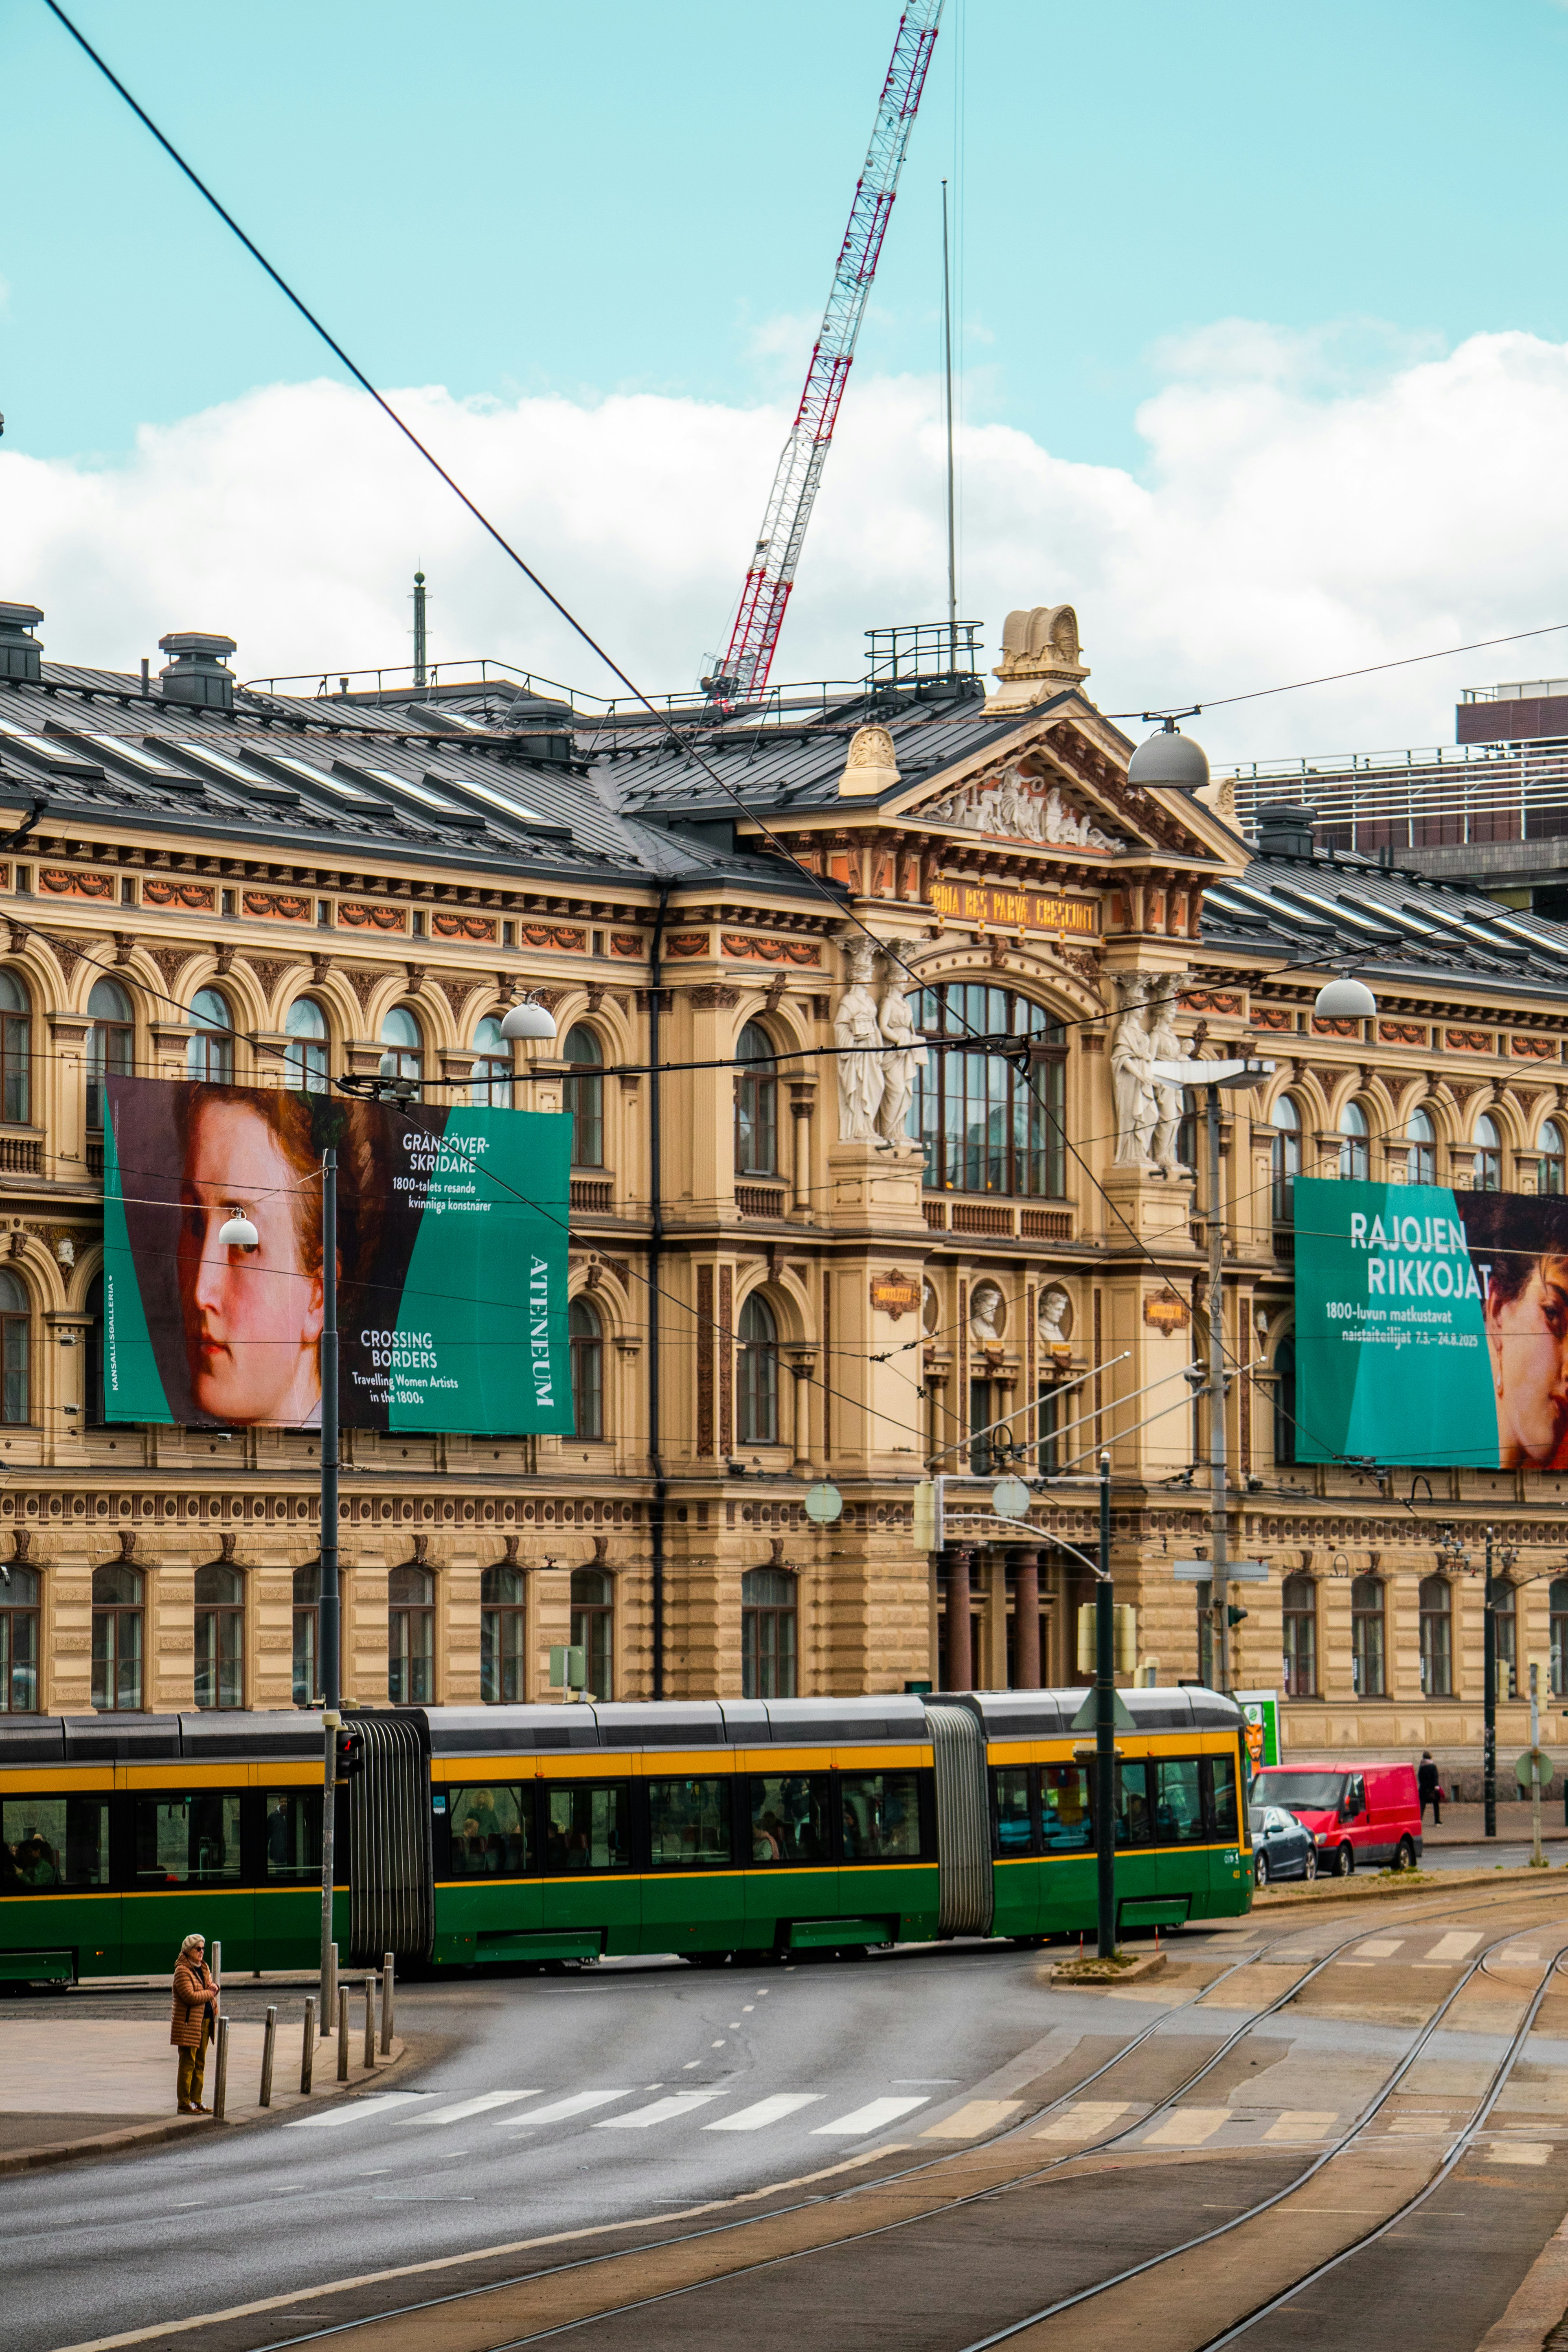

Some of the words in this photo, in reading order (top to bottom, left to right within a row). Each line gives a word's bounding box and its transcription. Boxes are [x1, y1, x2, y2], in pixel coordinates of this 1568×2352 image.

[965, 888, 988, 918] RES
[402, 1131, 490, 1154] GRÄNSÖVER-
[410, 1153, 477, 1173] SKRIDARE
[393, 1176, 442, 1192] 1800-talets
[443, 1181, 476, 1195] resande
[408, 1196, 446, 1214] kvinnliga
[448, 1197, 491, 1212] konstnärer
[1350, 1212, 1468, 1256] RAJOJEN
[1368, 1258, 1492, 1300] RIKKOJAT
[1326, 1302, 1387, 1322] 1800-luvun
[1390, 1305, 1452, 1324] matkustavat
[108, 1283, 118, 1391] KANSALLISGALLERIA
[360, 1330, 433, 1349] CROSSING
[530, 1255, 555, 1407] ATENEUM
[1342, 1326, 1411, 1350] naistaiteilijat
[372, 1350, 437, 1368] BORDERS
[352, 1372, 395, 1390] Travelling
[395, 1374, 428, 1388] Women
[430, 1375, 458, 1389] Artists
[369, 1390, 379, 1402] in
[381, 1390, 395, 1403] the
[396, 1391, 424, 1405] 1800s
